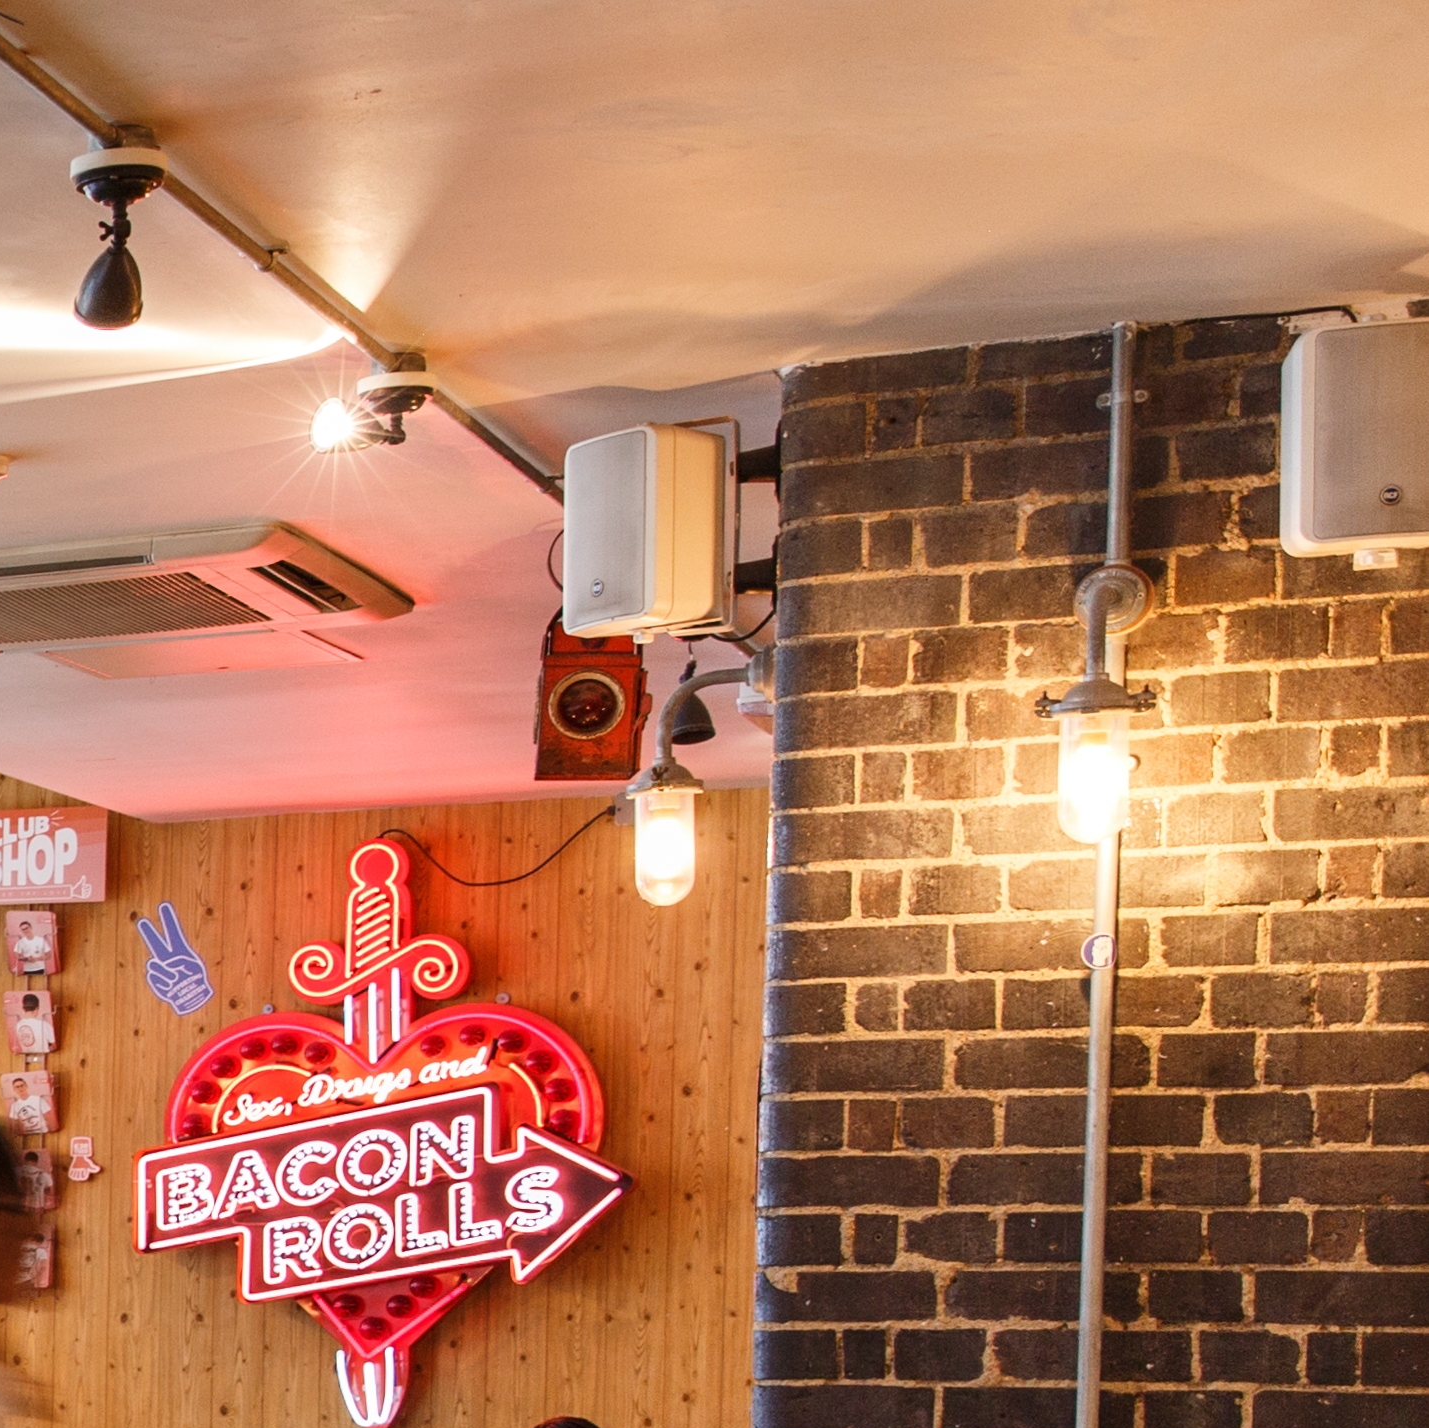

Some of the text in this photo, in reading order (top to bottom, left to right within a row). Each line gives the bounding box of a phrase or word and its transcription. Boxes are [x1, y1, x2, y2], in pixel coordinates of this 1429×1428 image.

[222, 1046, 488, 1126] Sex, Drugs and
[156, 1115, 475, 1231] BACON
[263, 1166, 564, 1285] ROLLS
